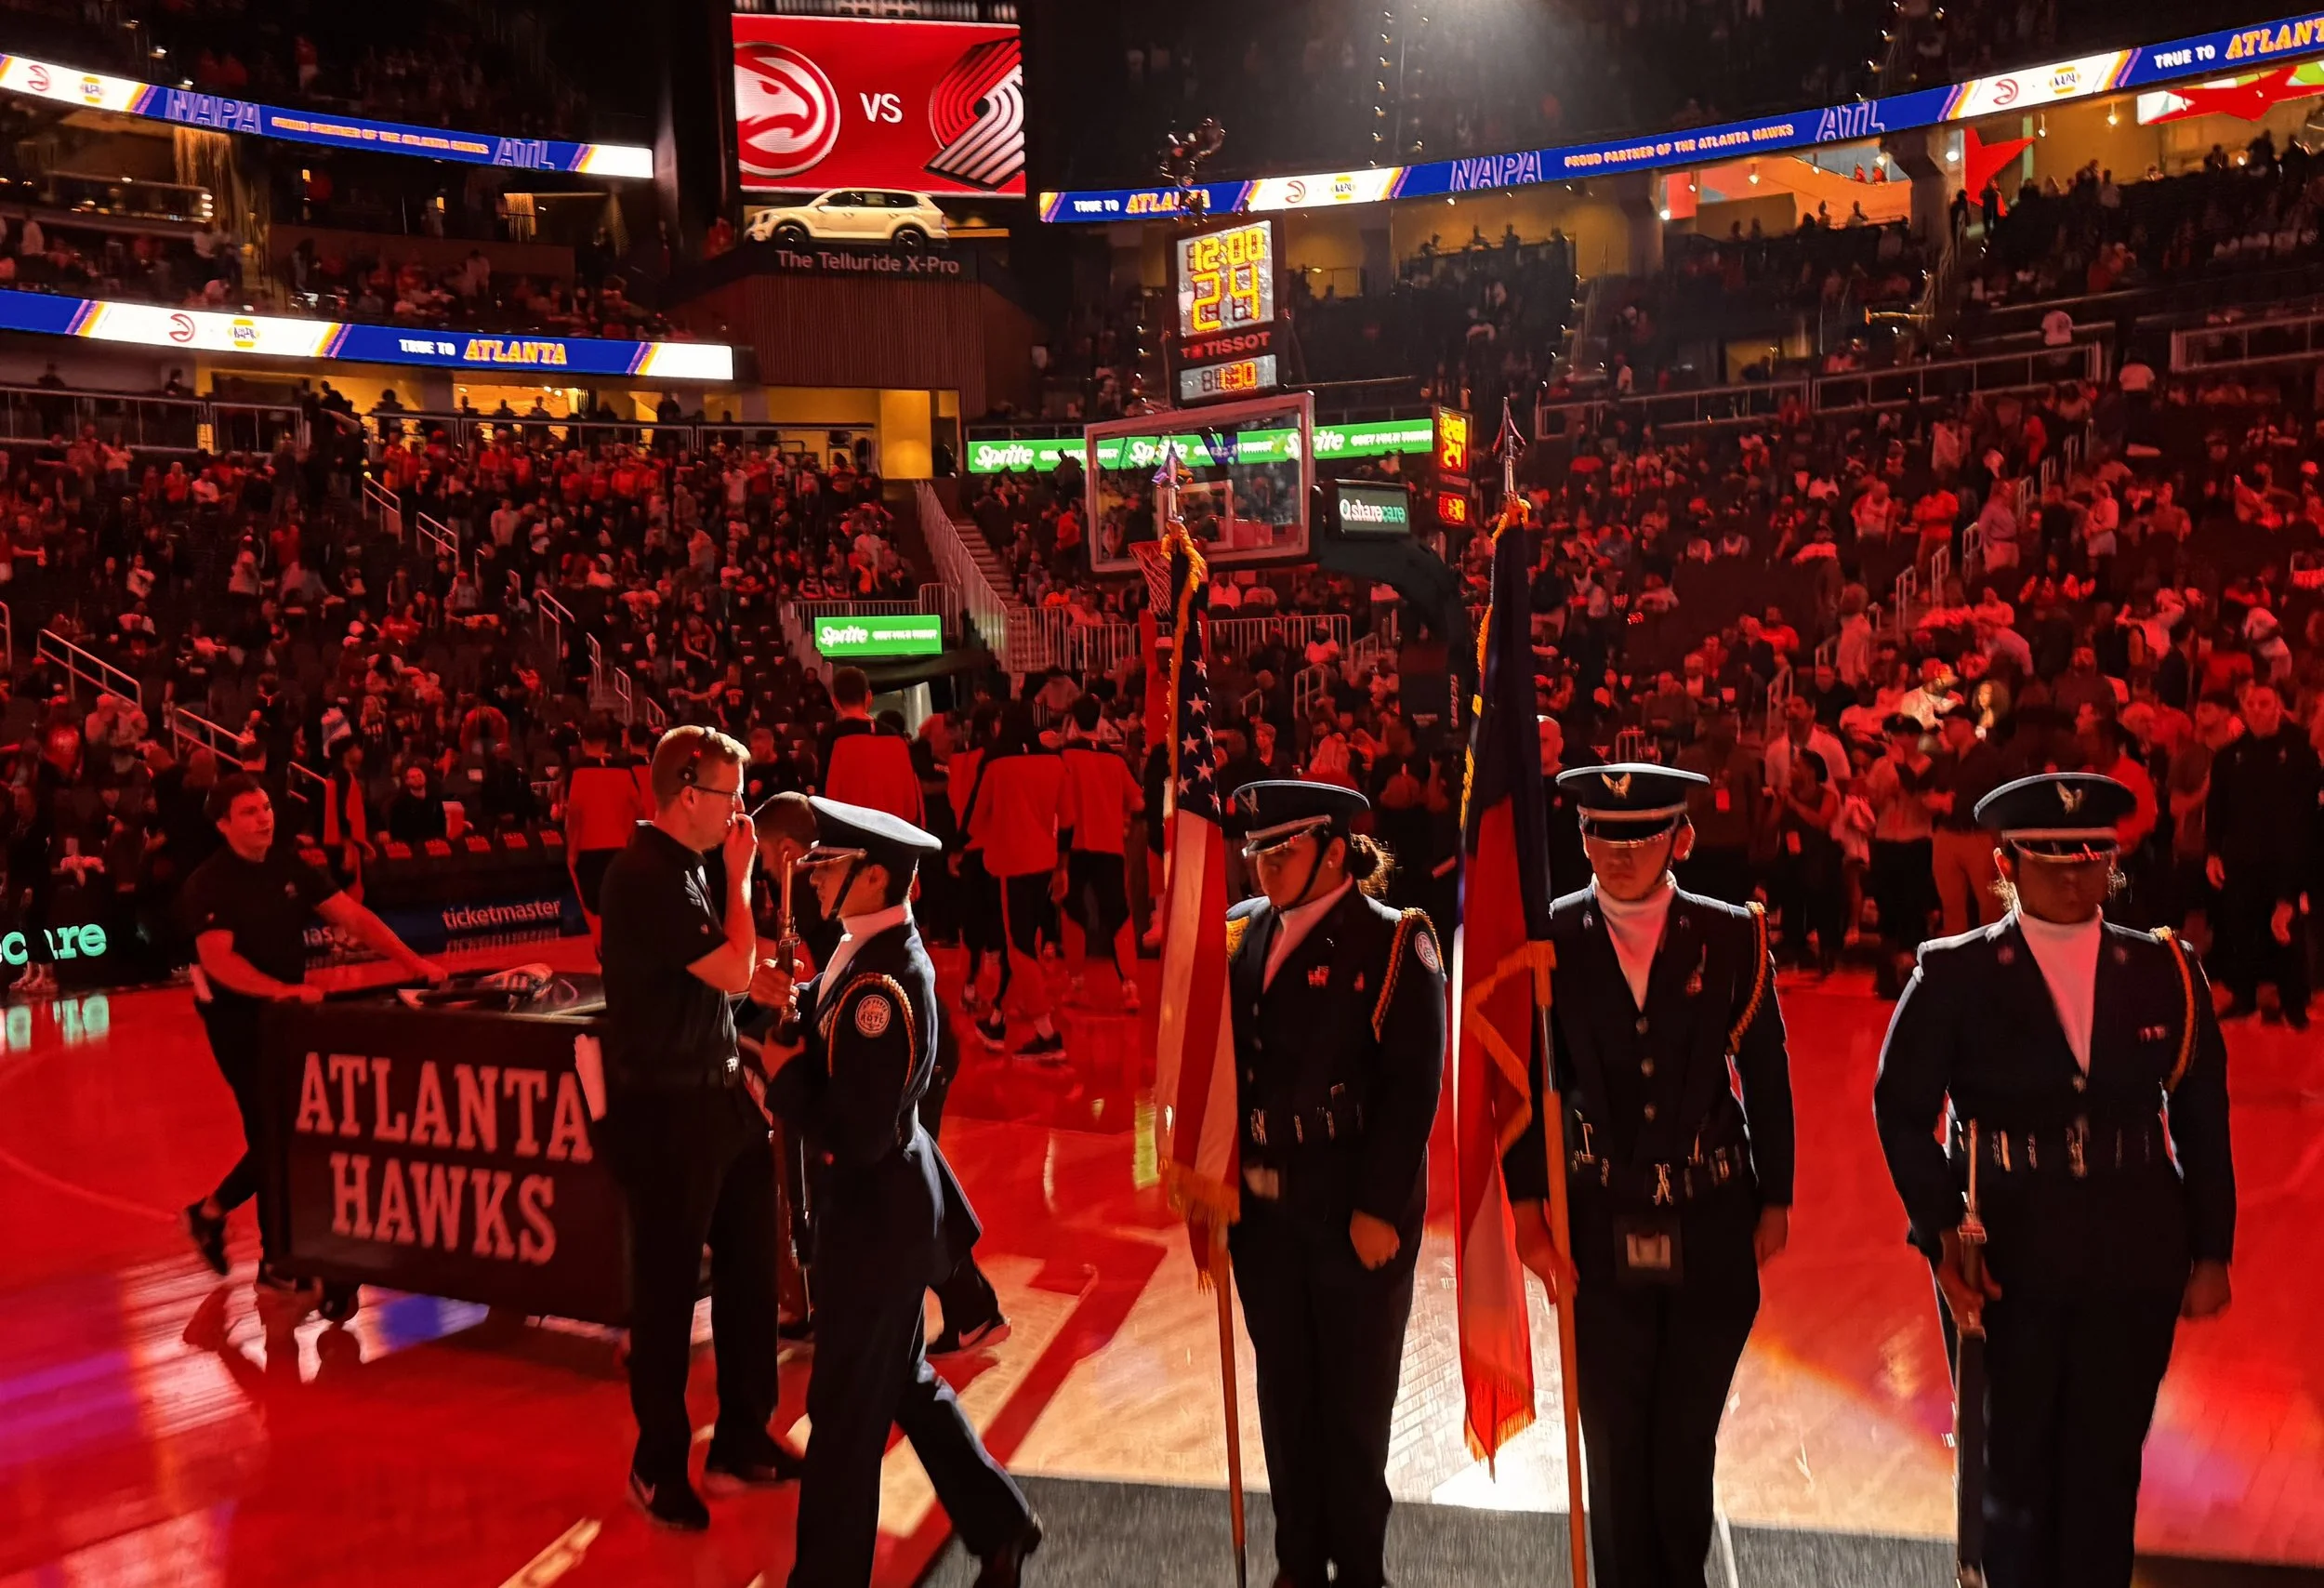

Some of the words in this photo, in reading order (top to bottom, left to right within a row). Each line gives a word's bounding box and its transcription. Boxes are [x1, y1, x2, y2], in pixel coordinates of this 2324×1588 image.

[2154, 49, 2192, 69] TRUE
[2195, 45, 2216, 61] TO
[165, 89, 263, 135] NAPA
[860, 93, 903, 124] VS
[1816, 100, 1885, 142] ATL
[493, 138, 555, 170] ATL
[1565, 153, 1603, 168] PROUD
[1604, 146, 1655, 164] PARTNER
[1656, 143, 1671, 155] OF
[1674, 139, 1696, 152] THE
[1698, 132, 1750, 150] ATLANTA
[1752, 125, 1794, 140] HAWKS
[1450, 151, 1543, 192] NAPA
[775, 250, 813, 269] The
[817, 252, 902, 271] Telluride
[906, 256, 960, 274] X-Pro
[1191, 263, 1261, 333] 24
[464, 338, 567, 365] ATLANTA
[1204, 331, 1271, 357] TISSOT
[975, 443, 1035, 470] Sprite
[819, 625, 869, 648] Sprite
[442, 898, 562, 930] ticketmaster
[296, 1052, 593, 1164] ATLANTA
[330, 1151, 558, 1266] HAWKS
